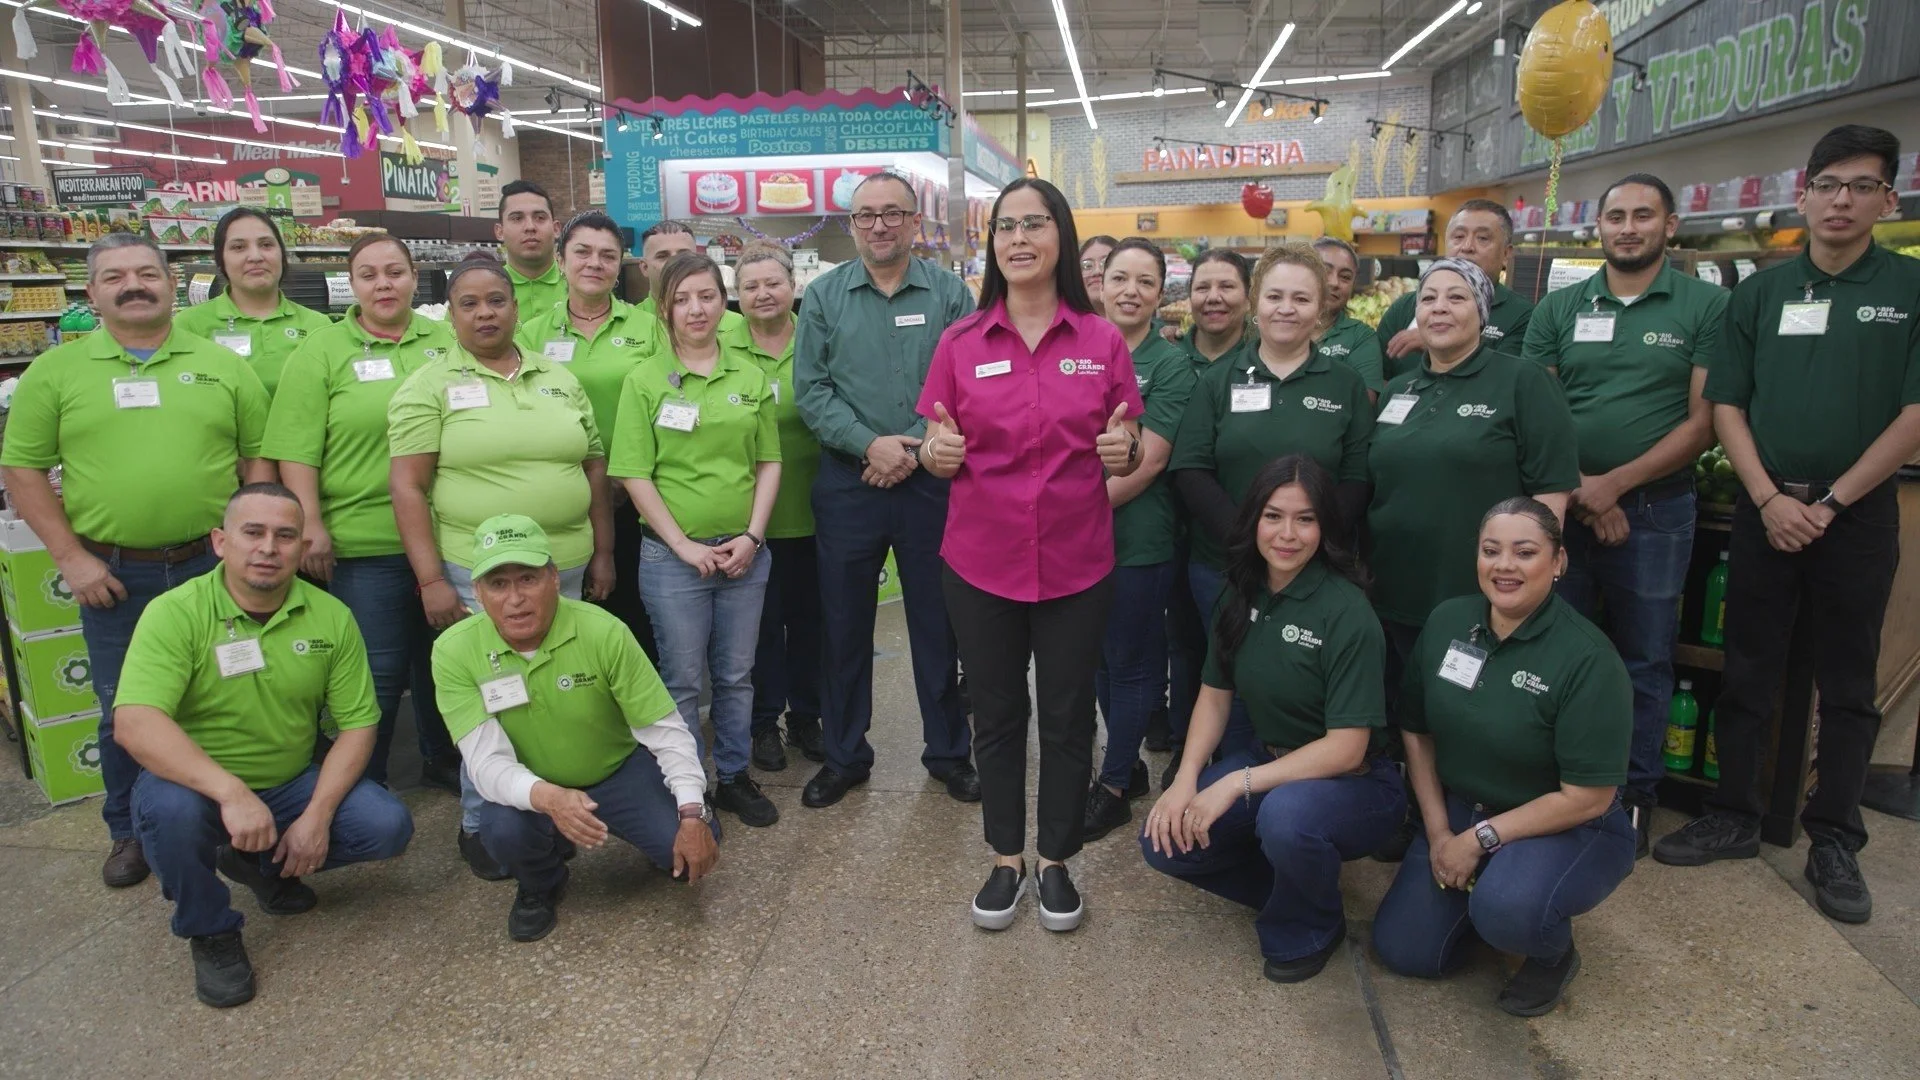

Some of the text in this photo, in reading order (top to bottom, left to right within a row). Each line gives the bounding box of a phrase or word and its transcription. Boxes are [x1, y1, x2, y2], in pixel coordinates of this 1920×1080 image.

[1612, 73, 1634, 145] Y
[1647, 0, 1870, 135] VERDURAS
[662, 117, 691, 130] TRES
[692, 115, 737, 129] LECHES
[740, 113, 801, 125] PASTELES
[803, 111, 836, 123] PARA
[837, 110, 872, 122] TODA
[740, 125, 822, 139] BIRTHDAY CAKES
[840, 122, 935, 134] CHOCOFLAN
[640, 130, 737, 147] Fruit Cakes
[844, 137, 930, 150] DESSERTS
[233, 140, 342, 161] Meat Mark
[670, 145, 737, 158] cheesecake
[748, 139, 812, 154] Postres
[1142, 139, 1306, 171] PANADERIA
[626, 151, 641, 200] WEDDING
[641, 155, 657, 194] CAKES
[58, 175, 143, 193] MEDITERRANEAN FOOD
[72, 192, 132, 202] mediterranean food
